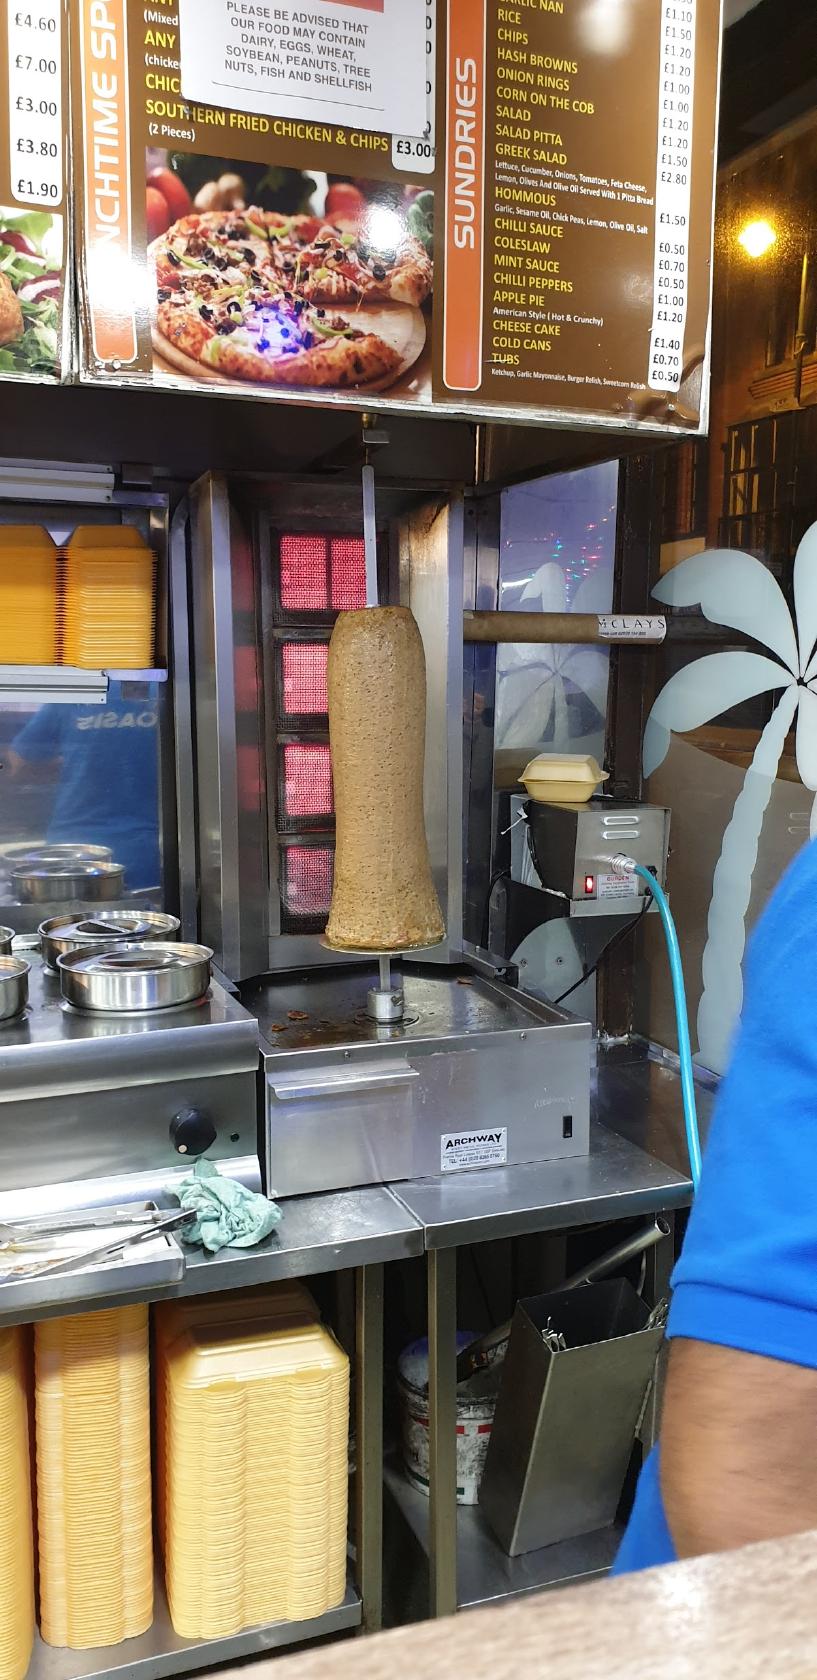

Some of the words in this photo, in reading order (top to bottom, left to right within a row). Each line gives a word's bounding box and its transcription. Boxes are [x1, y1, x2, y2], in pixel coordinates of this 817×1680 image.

[500, 0, 537, 8] LIC
[540, 0, 564, 14] NAN
[666, 8, 692, 22] £1.10
[15, 13, 56, 32] £4.60
[144, 9, 178, 26] (Mixed
[227, 1, 270, 18] PLEASE
[274, 9, 289, 20] BE
[292, 12, 339, 28] ADVISED
[342, 20, 368, 35] THAT
[498, 9, 521, 24] RICE
[144, 30, 176, 49] ANY
[231, 17, 255, 30] OUR
[258, 22, 289, 36] FOOD
[293, 26, 315, 39] MAY
[319, 31, 366, 48] CONTAIN
[497, 28, 529, 45] CHIPS
[665, 26, 692, 40] £1.50
[241, 33, 276, 50] DAIRY,
[280, 40, 314, 54] EGGS,
[317, 45, 356, 62] WHEAT,
[665, 45, 691, 59] £1.20
[16, 55, 57, 74] £7.00
[145, 53, 180, 69] (chicke
[226, 45, 283, 65] SOYBEAN,
[286, 56, 340, 74] PEANUTS,
[343, 64, 371, 78] TREE
[497, 47, 527, 64] HASH
[530, 54, 578, 74] BROWNS
[225, 59, 257, 76] NUTS,
[260, 66, 285, 79] FISH
[288, 70, 312, 82] AND
[314, 74, 372, 92] SHELLFISH
[664, 62, 690, 77] £1.20
[146, 73, 180, 93] CHIC
[497, 67, 534, 85] ONION
[537, 74, 570, 91] RINGS
[663, 81, 690, 95] £1.00
[16, 97, 57, 116] £3.00
[496, 86, 527, 102] CORN
[530, 92, 546, 106] ON
[550, 95, 570, 110] THE
[572, 100, 595, 114] COB
[663, 99, 689, 113] £1.00
[496, 105, 531, 121] SALAD
[146, 99, 226, 126] SOUTHERN
[230, 113, 269, 133] FRIED
[273, 121, 332, 143] CHICKEN
[335, 130, 347, 145] &
[350, 133, 389, 152] CHIPS
[149, 122, 158, 136] (2
[161, 125, 196, 142] Pieces)
[662, 117, 689, 131] £1.20
[496, 124, 531, 140] SALAD
[534, 130, 563, 146] PITTA
[662, 136, 688, 150] £1.20
[17, 138, 58, 157] £3.80
[396, 140, 431, 158] £3.00
[454, 58, 477, 249] SUNDRIES
[495, 143, 530, 159] GREEK
[533, 149, 567, 165] SALAD
[661, 153, 688, 168] £1.50
[495, 160, 520, 173] Lettuce,
[521, 165, 553, 178] Cucumber,
[555, 170, 578, 182] Onions,
[579, 173, 610, 188] Tomatoes,
[611, 179, 623, 188] Feta
[624, 181, 647, 194] Cheese,
[661, 171, 687, 186] £2.80
[17, 179, 58, 198] £1.90
[495, 173, 518, 184] Lemon,
[520, 176, 538, 187] Olives
[540, 180, 552, 189] And
[553, 182, 569, 192] Olive
[570, 184, 578, 193] Oil
[580, 186, 601, 197] Served
[601, 189, 616, 200] With
[617, 192, 621, 200] 1
[622, 192, 635, 203] Pitta
[636, 195, 654, 206] Bread
[495, 186, 556, 206] HOMMOUS
[494, 203, 515, 215] Garlic,
[516, 207, 539, 218] Sesame
[540, 210, 551, 220] Oil,
[552, 212, 569, 222] Chick
[586, 217, 608, 229] Lemon,
[609, 221, 625, 231] Olive
[637, 225, 648, 235] Salt
[660, 213, 686, 226] £1.50
[494, 218, 527, 233] CHILLI
[529, 222, 564, 238] SAUCE
[494, 236, 551, 254] COLESLAW
[659, 242, 685, 256] £0.50
[494, 254, 523, 268] MINT
[525, 258, 560, 273] SAUCE
[658, 260, 685, 273] £0.70
[493, 272, 526, 287] CHILLI
[528, 276, 573, 292] PEPPERS
[658, 276, 684, 290] £0.50
[493, 290, 526, 304] APPLE
[529, 294, 545, 307] PIE
[658, 294, 684, 307] £1.00
[493, 306, 527, 318] American
[528, 310, 546, 320] Style
[551, 313, 565, 321] Hot
[566, 314, 572, 322] &
[573, 315, 604, 327] Crunchy)
[657, 310, 683, 323] £1.20
[492, 320, 532, 333] CHEESE
[534, 323, 561, 336] CAKE
[492, 336, 521, 349] COLD
[523, 339, 552, 351] CANS
[654, 337, 680, 351] £1.40
[491, 352, 520, 365] TUBS
[653, 354, 679, 366] £0.70
[491, 368, 516, 377] Ketchup,
[516, 370, 532, 378] Garlic
[567, 374, 584, 383] Burger
[652, 370, 679, 383] £0.50
[446, 1133, 502, 1150] ARCHWAY
